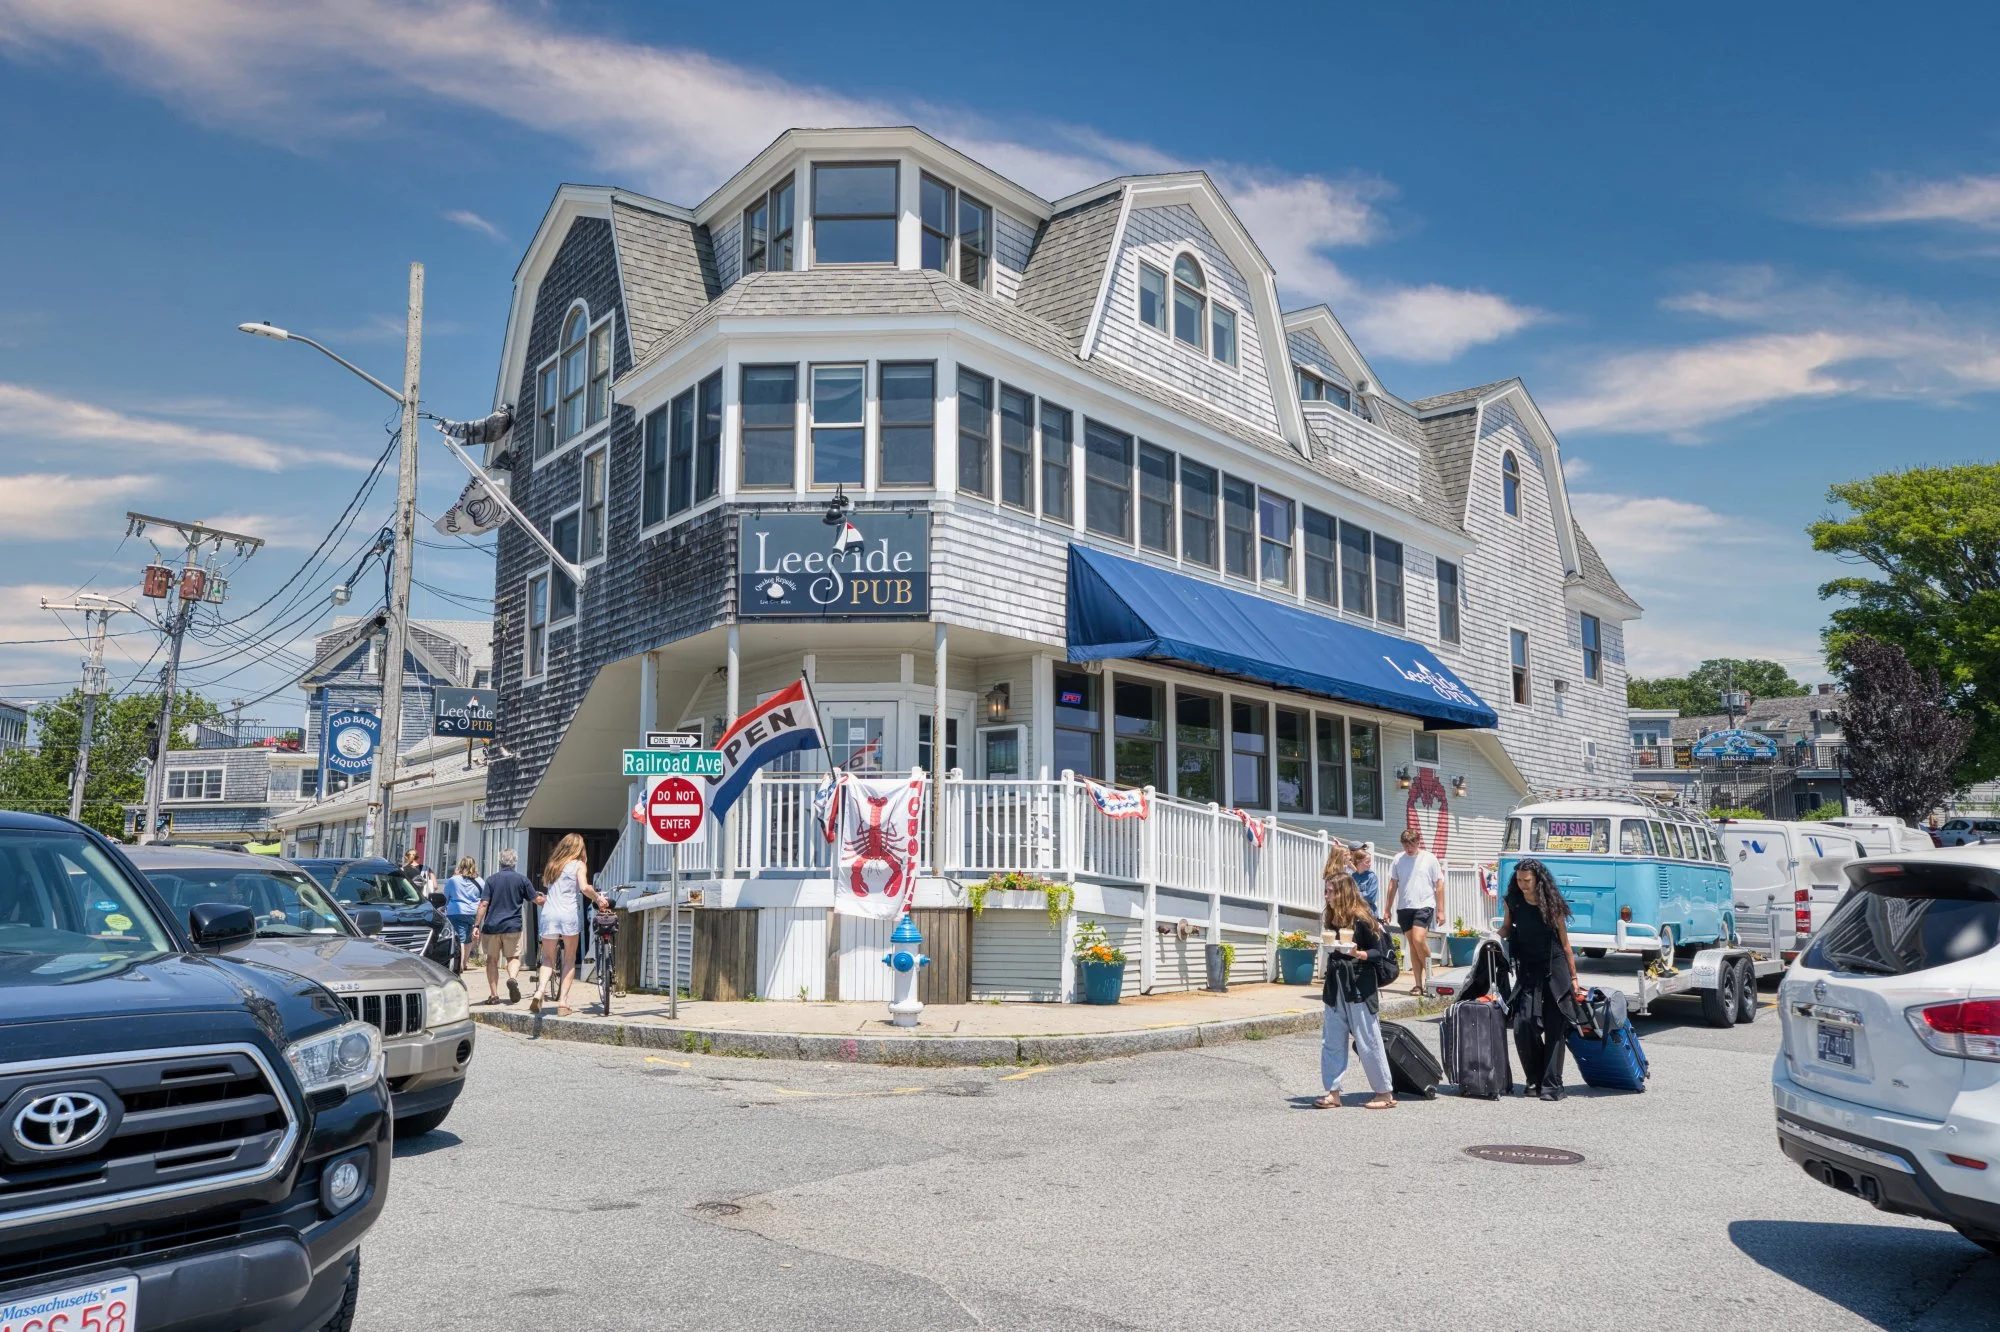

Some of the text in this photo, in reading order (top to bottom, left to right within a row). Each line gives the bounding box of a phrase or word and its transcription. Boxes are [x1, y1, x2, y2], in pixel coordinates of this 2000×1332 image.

[775, 575, 797, 591] Republic
[850, 579, 913, 605] PUB
[1063, 693, 1082, 702] OPEN
[332, 715, 379, 731] OLD BARN
[471, 719, 493, 731] PUB
[330, 754, 373, 769] LIQUORS
[624, 753, 722, 773] Railroad Ave
[657, 791, 695, 801] DO NOT
[660, 819, 691, 829] ENTER
[1550, 822, 1590, 836] FOR SALE
[1, 1291, 99, 1321] Massachusetts
